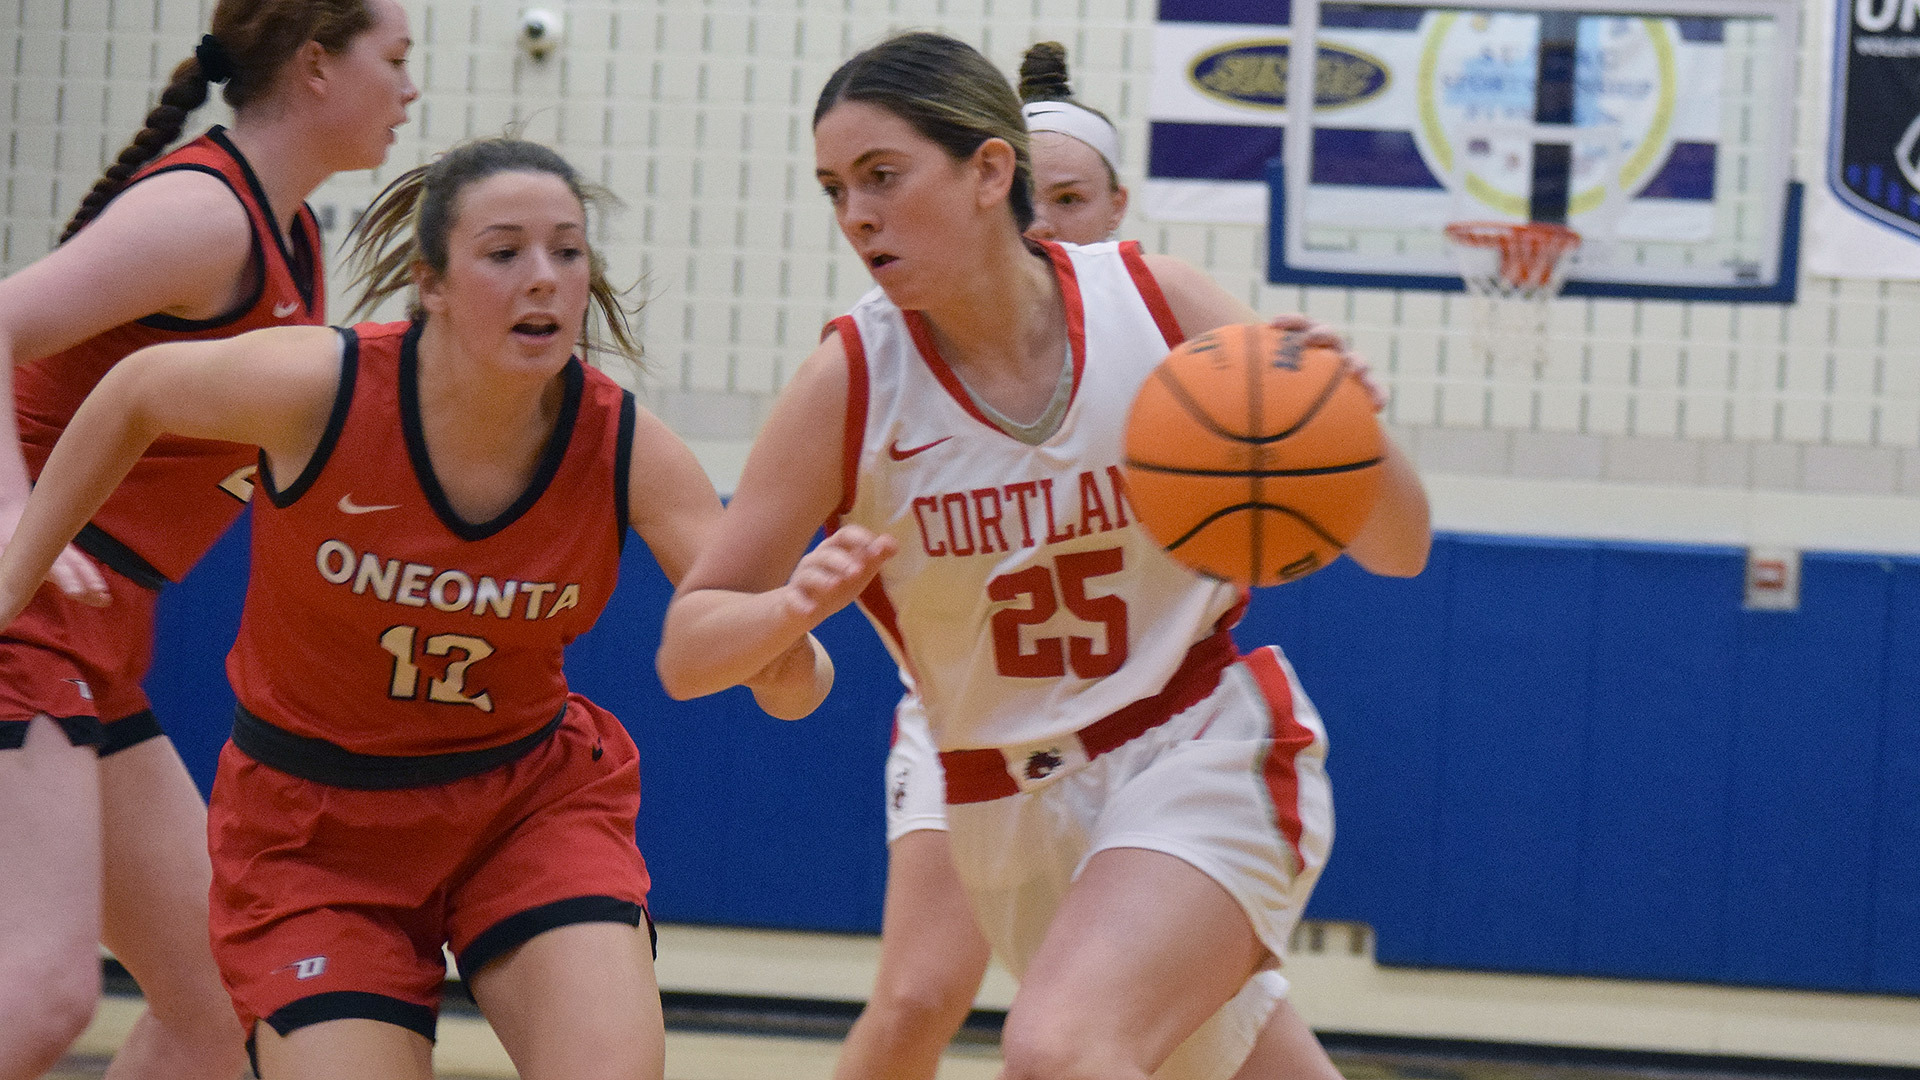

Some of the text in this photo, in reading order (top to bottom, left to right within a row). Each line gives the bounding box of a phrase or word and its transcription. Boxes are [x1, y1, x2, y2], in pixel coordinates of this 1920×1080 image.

[315, 538, 580, 620] ONEONTA
[987, 546, 1128, 680] 25
[379, 624, 497, 714] 12
